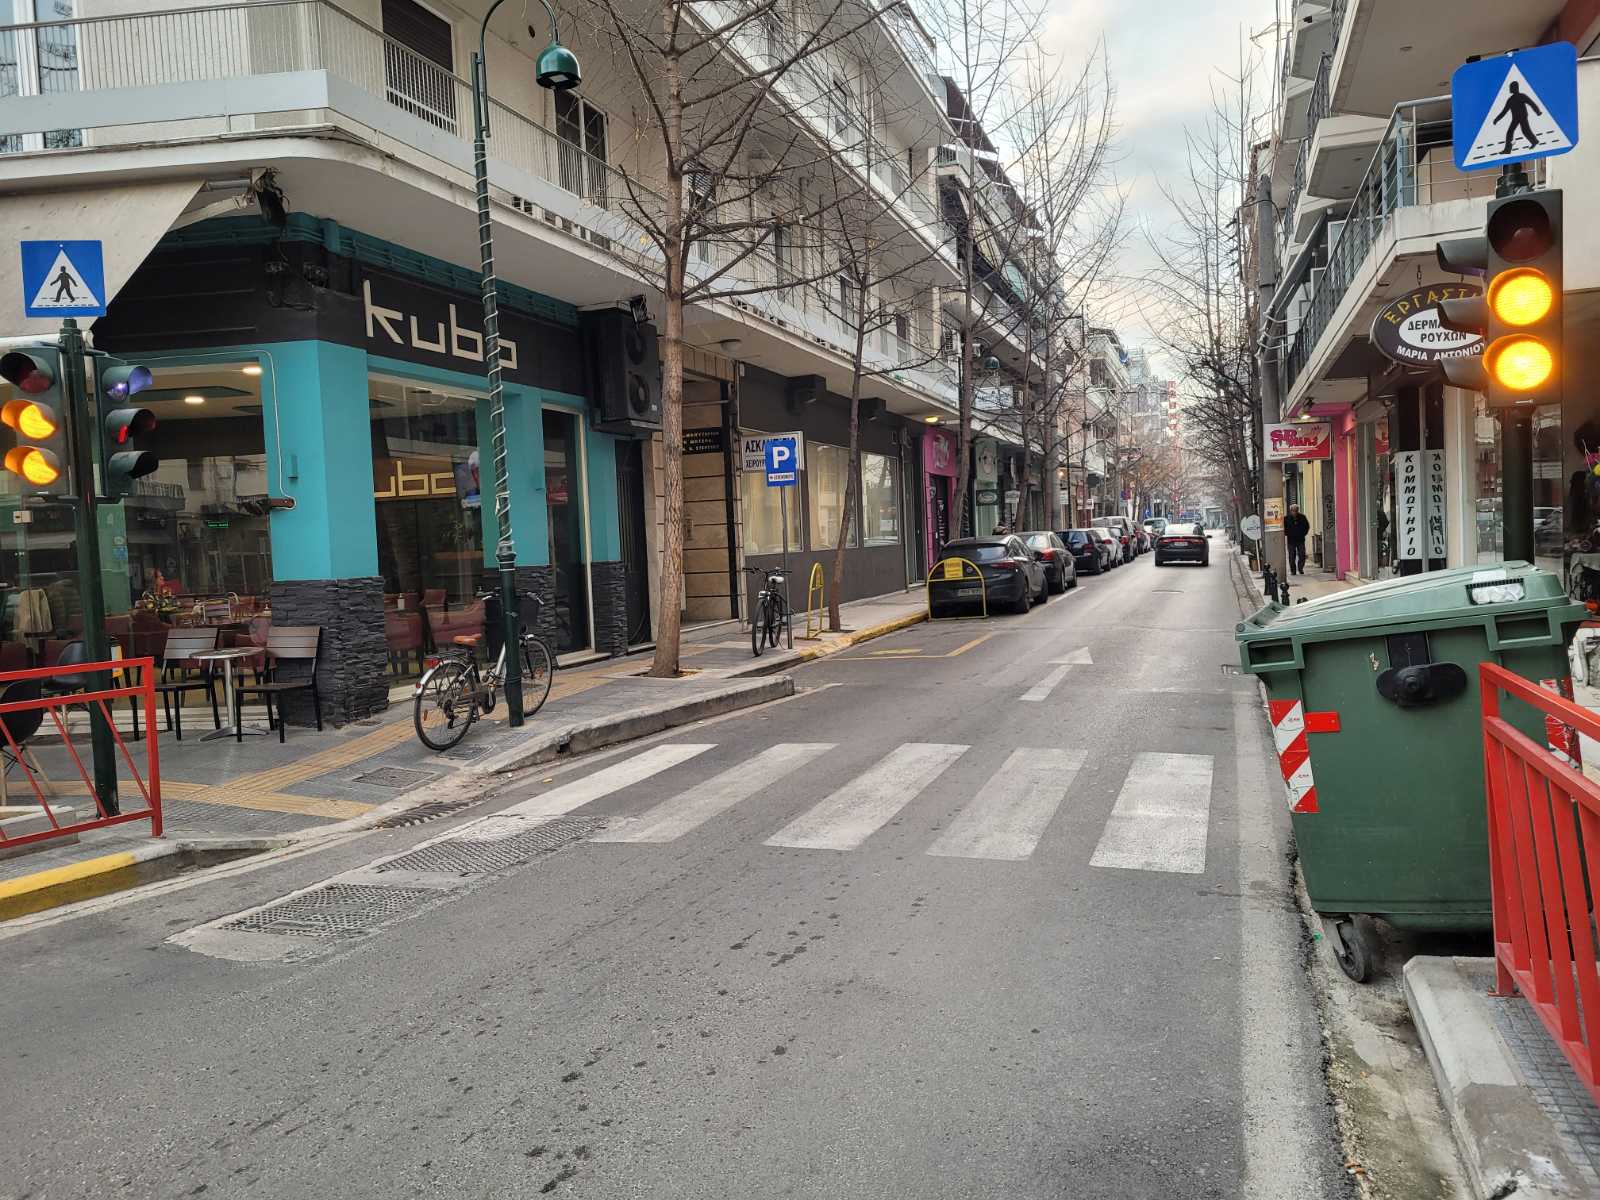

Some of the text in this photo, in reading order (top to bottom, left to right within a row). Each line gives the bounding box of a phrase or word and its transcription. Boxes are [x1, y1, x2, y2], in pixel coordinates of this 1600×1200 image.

[1384, 288, 1476, 325] ΕΡΓΑΣΤ
[363, 279, 518, 370] kubo
[1420, 331, 1467, 343] ΡΟΥΧΩΝ
[1396, 345, 1428, 361] ΜΑΡΙΑ
[772, 446, 790, 469] P
[1404, 454, 1416, 556] ΚΟΜΜΩΤΗΡΙΟ
